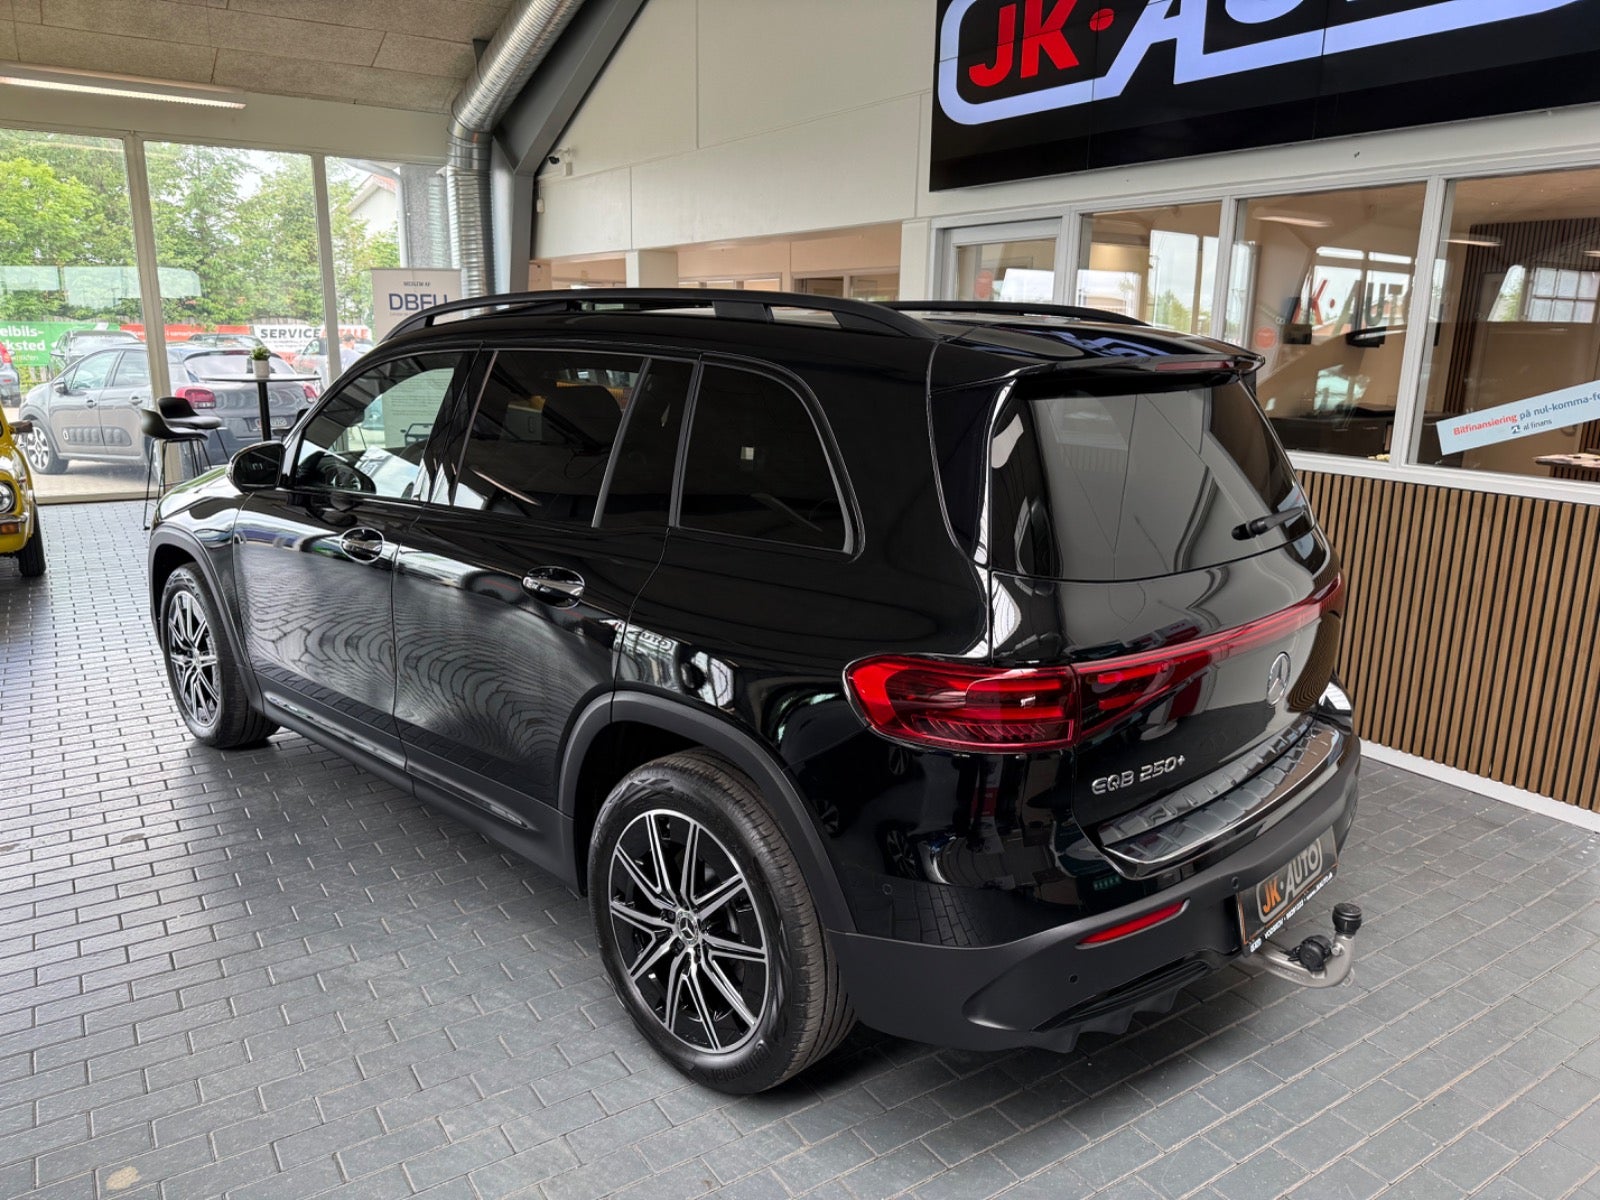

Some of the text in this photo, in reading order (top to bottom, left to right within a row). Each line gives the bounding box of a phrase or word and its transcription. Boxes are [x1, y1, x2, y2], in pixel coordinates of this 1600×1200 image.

[968, 0, 1080, 87] JK
[1453, 413, 1518, 436] Bilfinansiering
[1520, 410, 1532, 421] på
[1531, 418, 1552, 430] finans
[1091, 754, 1186, 795] EQB 250+
[1262, 875, 1282, 914] JK
[1285, 843, 1319, 899] AUTO
